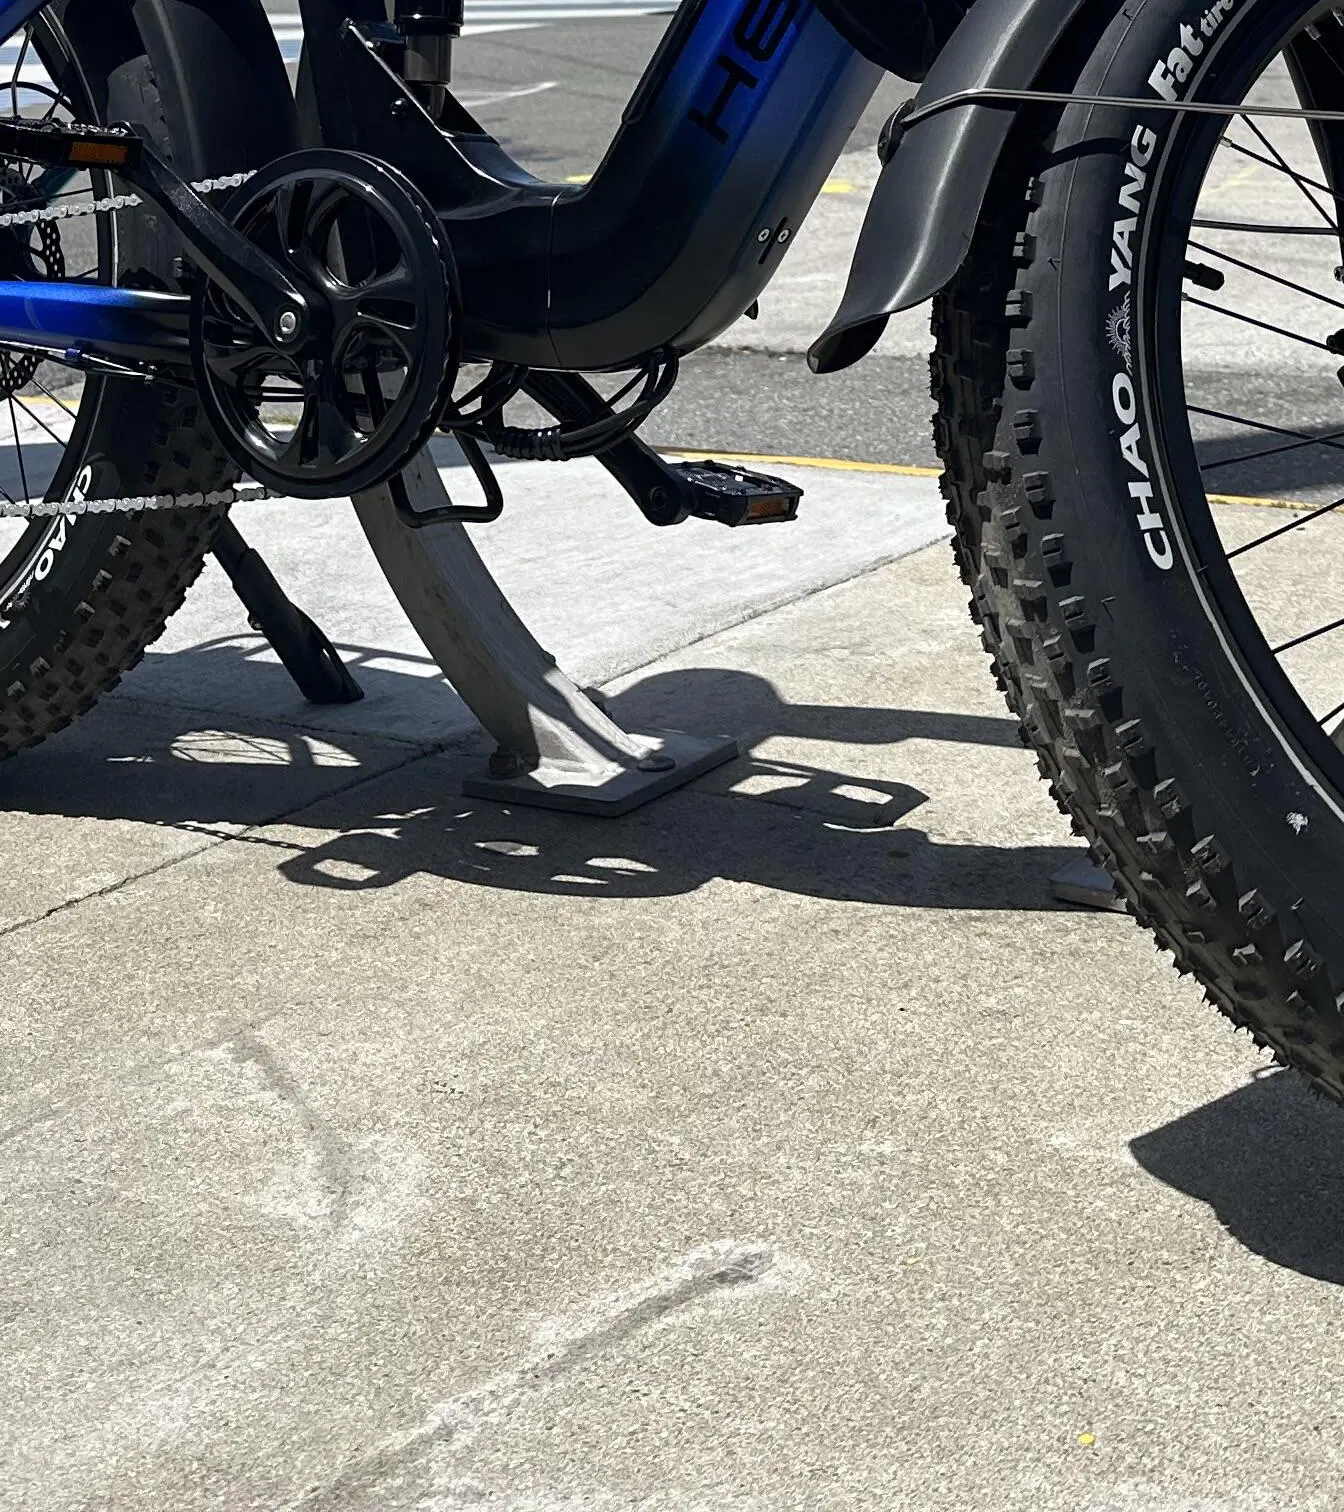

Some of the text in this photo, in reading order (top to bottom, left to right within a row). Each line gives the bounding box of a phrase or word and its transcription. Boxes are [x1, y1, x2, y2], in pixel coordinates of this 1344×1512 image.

[1147, 21, 1205, 104] Fat
[1107, 122, 1174, 571] CHAO YANG
